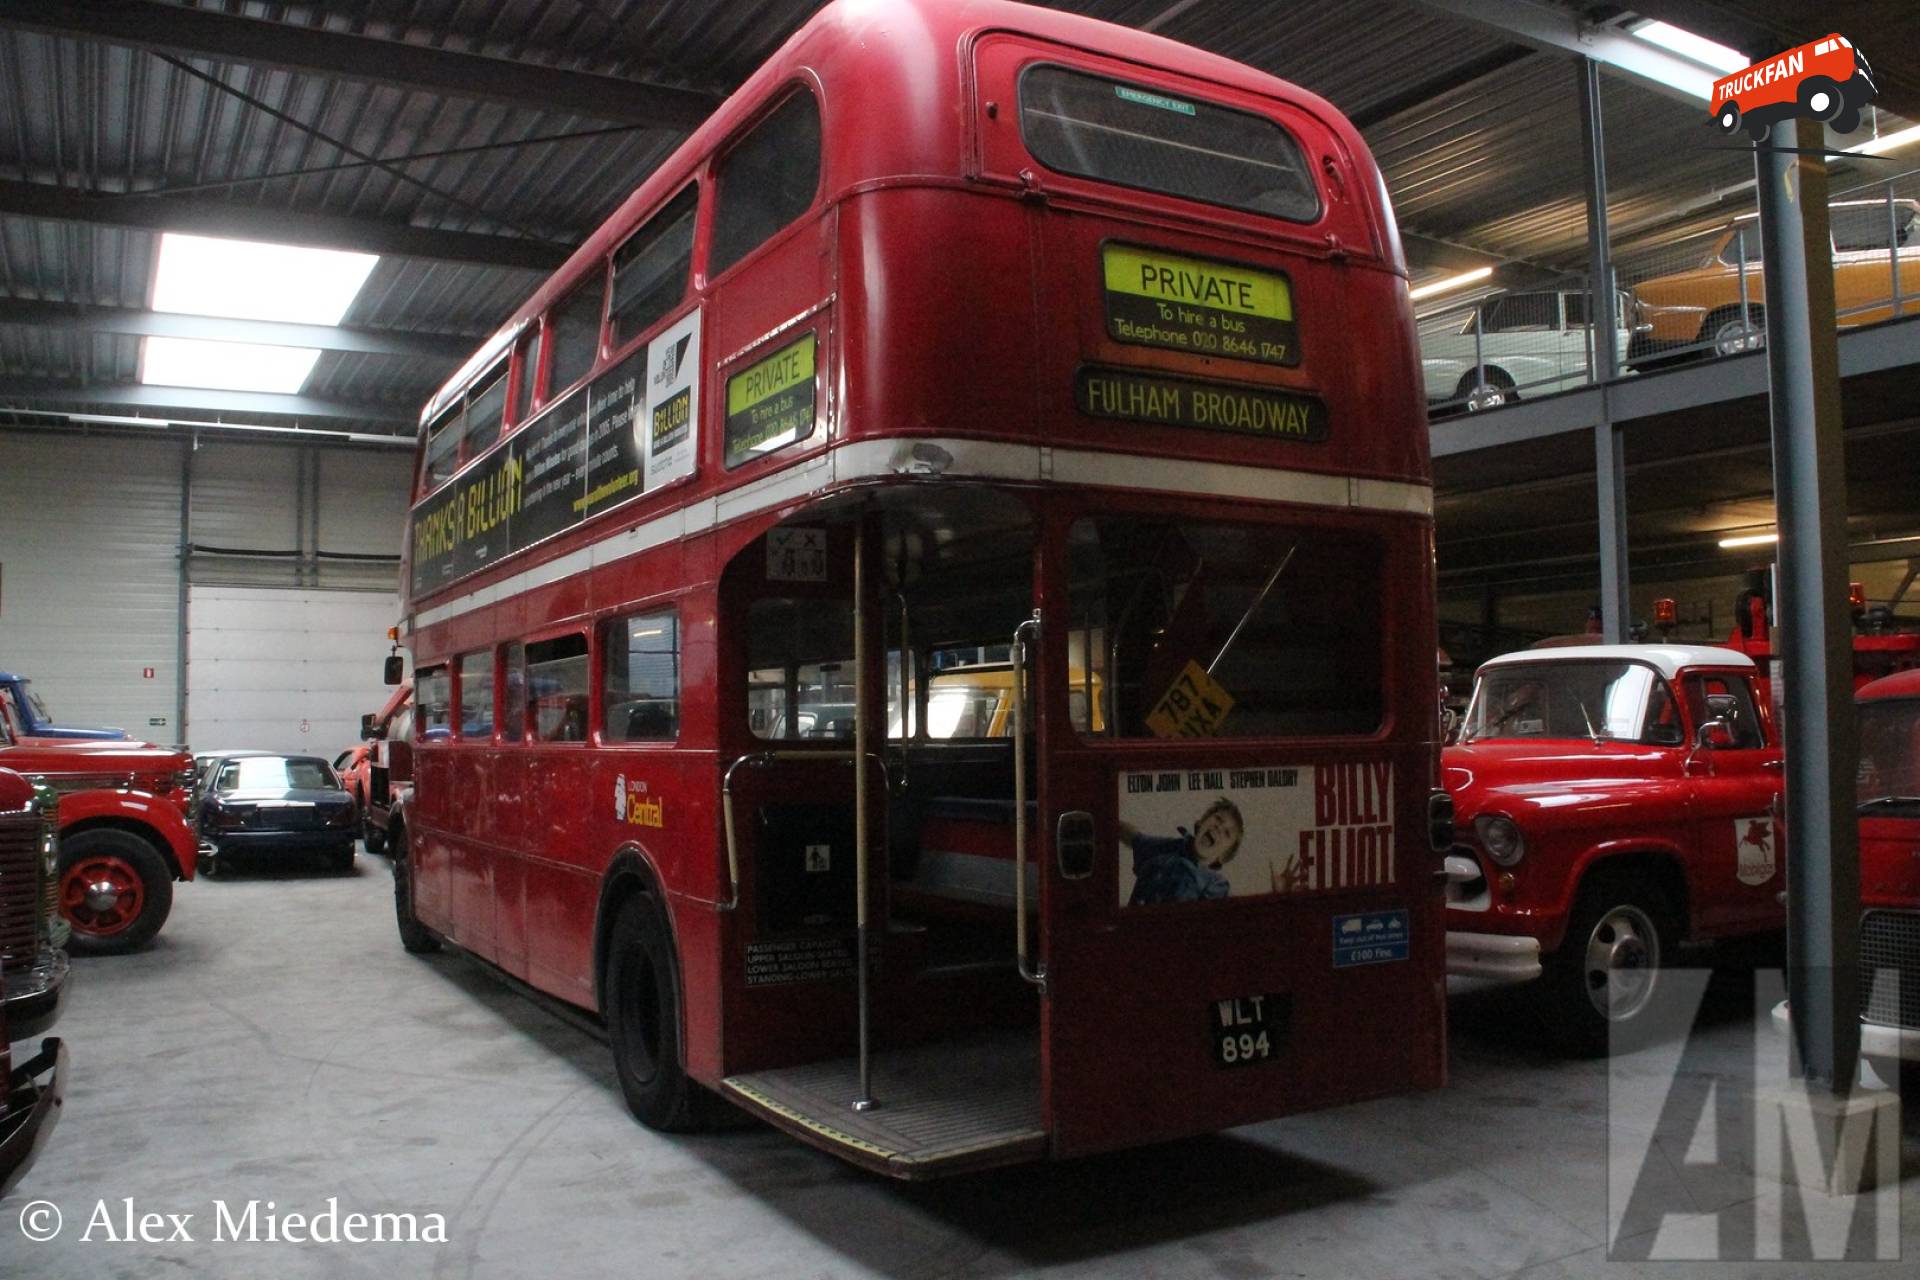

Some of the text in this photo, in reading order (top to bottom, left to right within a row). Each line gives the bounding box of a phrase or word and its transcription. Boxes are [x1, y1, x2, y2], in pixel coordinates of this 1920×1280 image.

[1141, 263, 1255, 309] PRIVATE
[1114, 318, 1188, 345] Telephone
[1193, 331, 1217, 349] 020
[1222, 338, 1257, 355] 8646
[1156, 302, 1246, 333] To hire a bus
[745, 350, 801, 403] PRIVATE
[654, 394, 689, 436] BILLION
[1088, 379, 1310, 434] FULHAM BROADWAY
[466, 453, 523, 541] BILLION
[1128, 768, 1298, 793] ELTON JOHN LEE HALL STEPHEN DALDRY
[1315, 762, 1391, 827] BILLY
[627, 793, 663, 828] Central
[1299, 825, 1393, 891] ELLIOT
[1218, 996, 1265, 1027] WLT
[1221, 1031, 1270, 1062] 894
